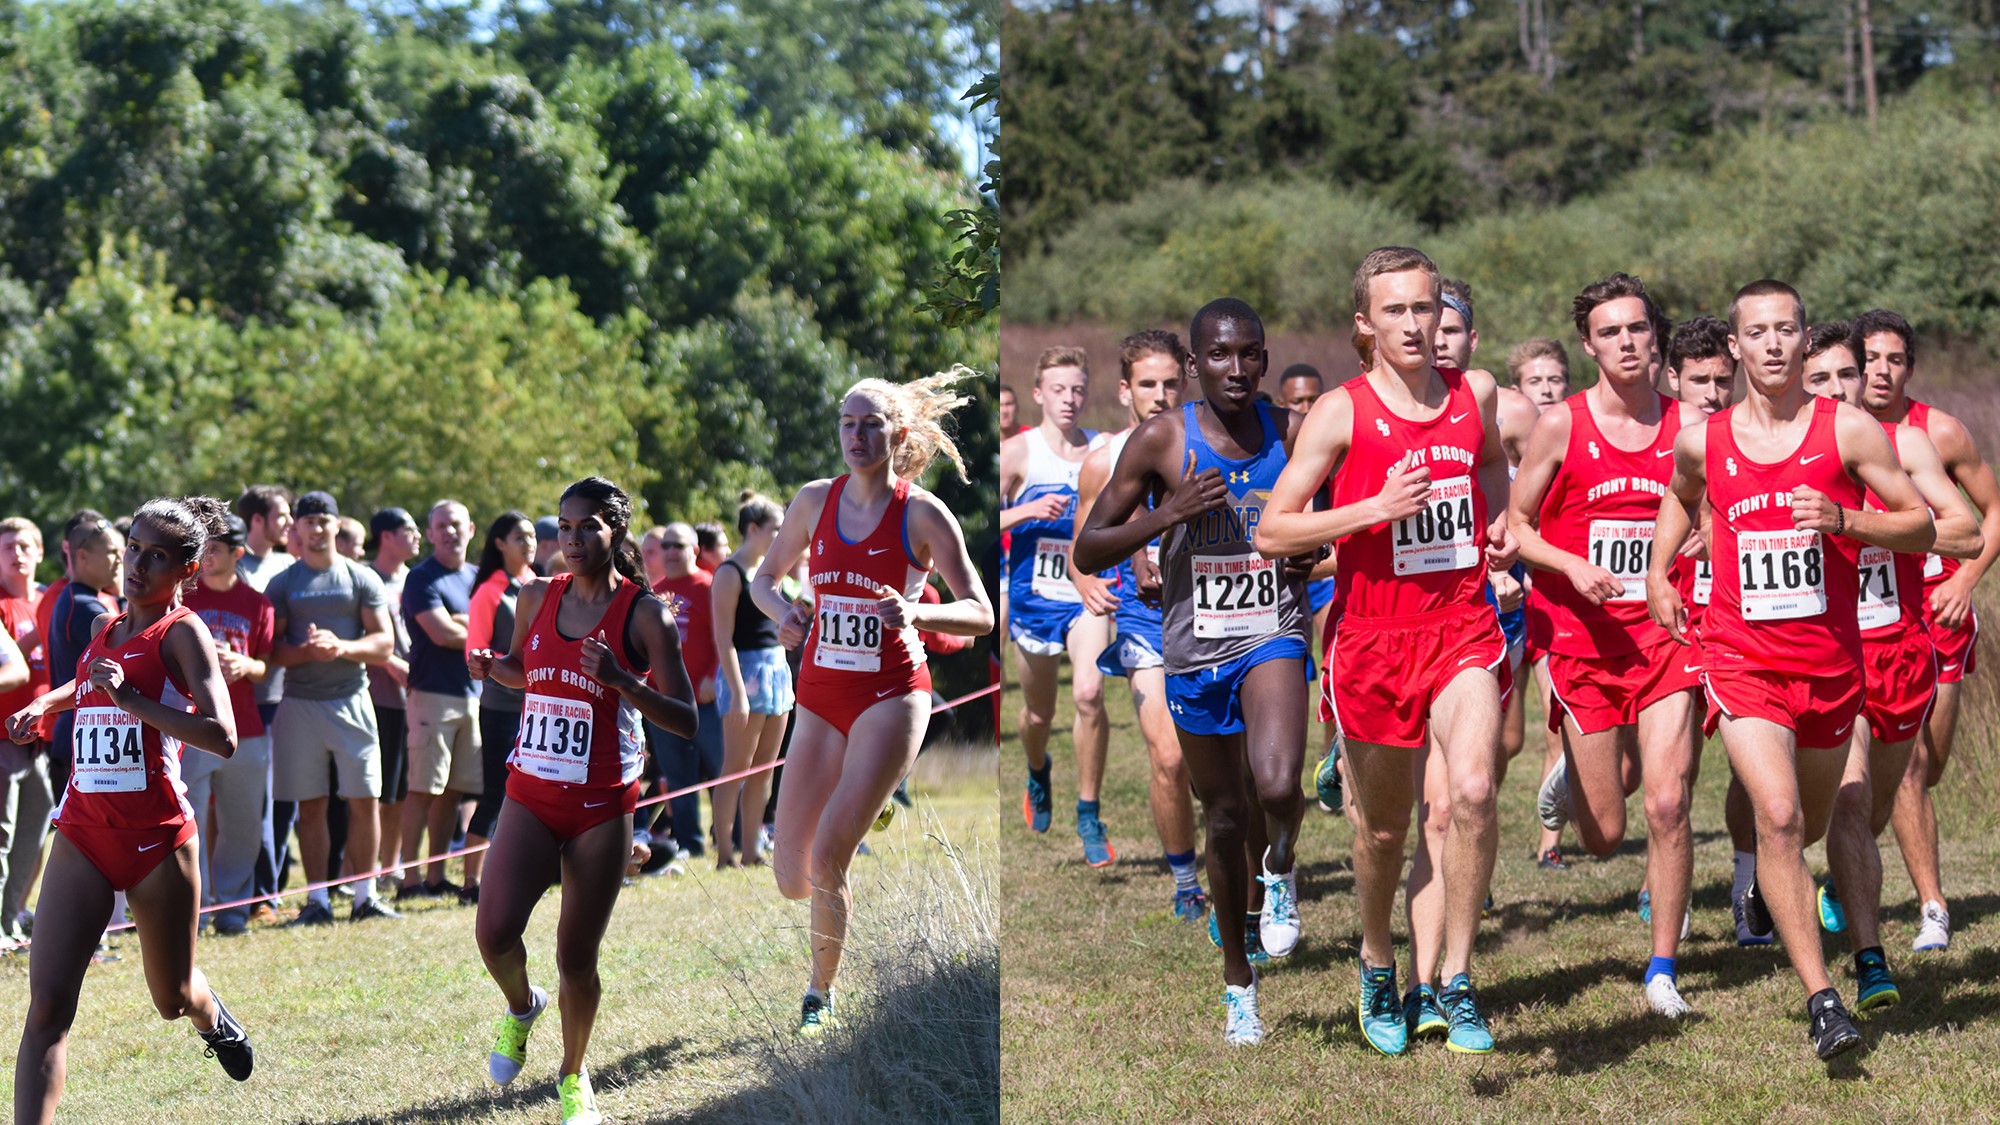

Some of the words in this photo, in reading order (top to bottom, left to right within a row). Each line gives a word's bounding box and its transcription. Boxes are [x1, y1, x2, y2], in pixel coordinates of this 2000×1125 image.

[1431, 445, 1474, 467] BROOK
[1425, 487, 1442, 502] IME
[1443, 482, 1469, 499] RACING
[1587, 477, 1628, 502] STONY
[1728, 492, 1770, 523] STONY
[1397, 498, 1473, 547] 1084
[1592, 526, 1610, 539] JUST
[1611, 527, 1620, 539] IN
[1621, 527, 1637, 539] TIME
[1740, 540, 1757, 552] JUST
[1758, 539, 1768, 551] IN
[1769, 537, 1789, 551] TIME
[1790, 534, 1820, 549] RACING
[1194, 561, 1213, 573] JUST
[1214, 562, 1223, 574] IN
[1225, 561, 1244, 574] TIME
[1246, 560, 1274, 573] RACING
[1741, 548, 1822, 591] 1168
[1863, 551, 1891, 566] RACING
[811, 571, 841, 587] STONY
[1196, 570, 1275, 611] 1228
[1858, 564, 1895, 603] 71
[839, 602, 854, 613] TIME
[820, 611, 880, 649] 1138
[526, 667, 556, 687] STONY
[560, 669, 605, 700] BROOK
[76, 714, 89, 726] JUST
[89, 714, 95, 726] IN
[97, 713, 111, 726] TIME
[113, 713, 139, 726] RACING
[527, 700, 539, 713] JUST
[540, 702, 546, 715] IN
[547, 703, 563, 717] TIME
[564, 705, 591, 720] RACING
[75, 727, 142, 765] 1134
[522, 713, 590, 757] 1139
